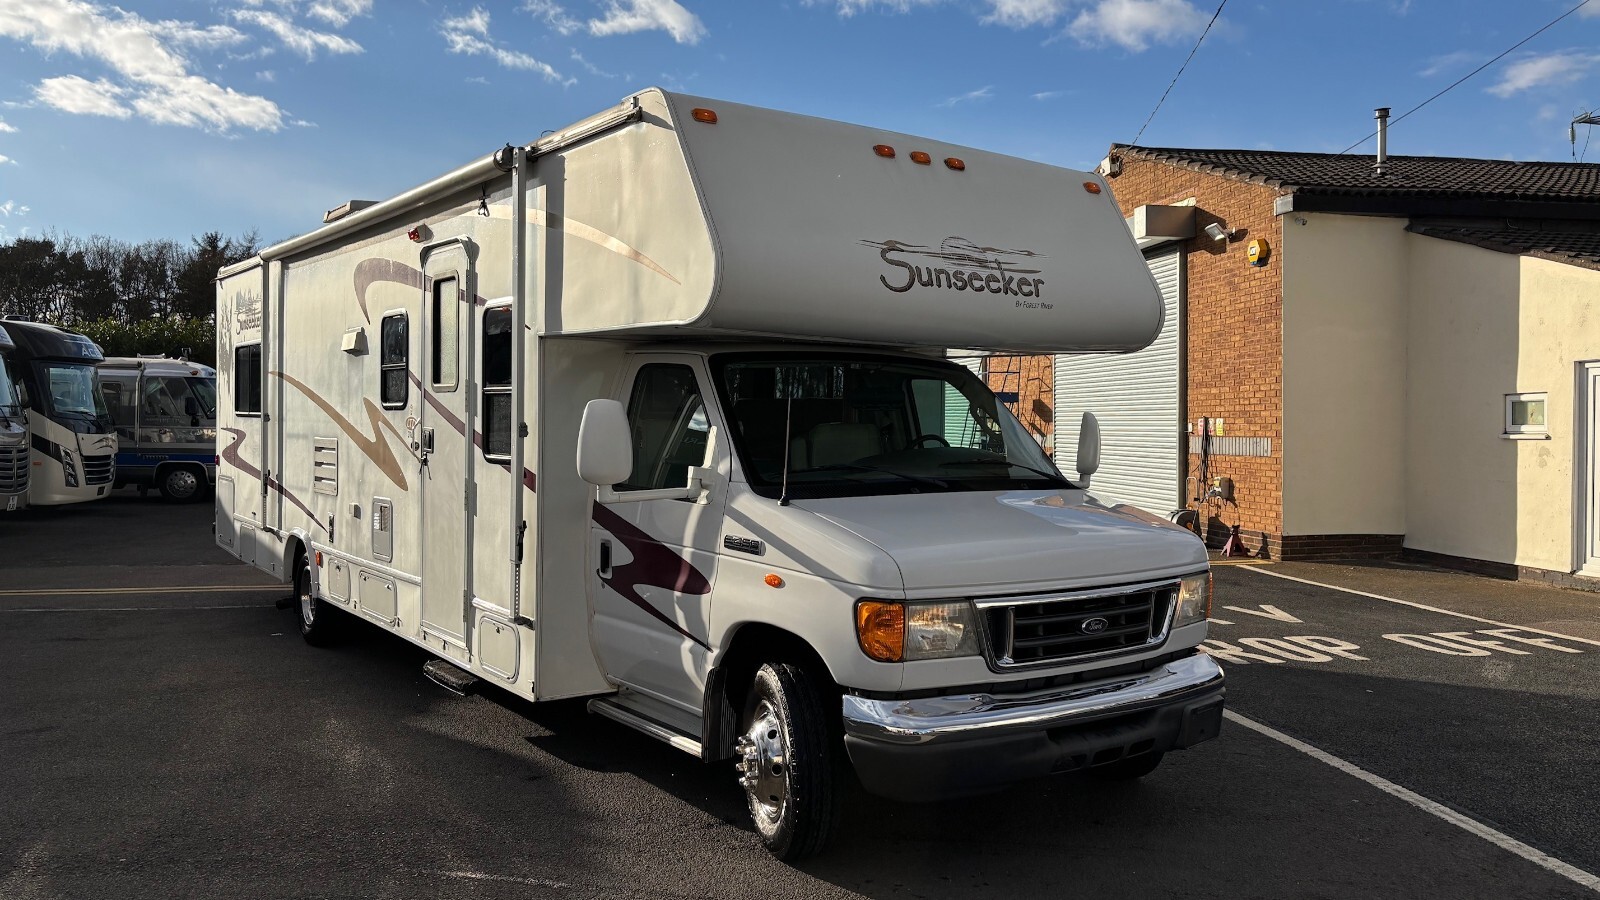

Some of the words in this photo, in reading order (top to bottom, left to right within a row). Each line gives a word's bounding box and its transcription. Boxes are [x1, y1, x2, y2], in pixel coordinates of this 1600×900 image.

[880, 245, 1045, 297] Sunseeker
[1196, 635, 1371, 665] ROP
[1381, 629, 1584, 657] OFF
